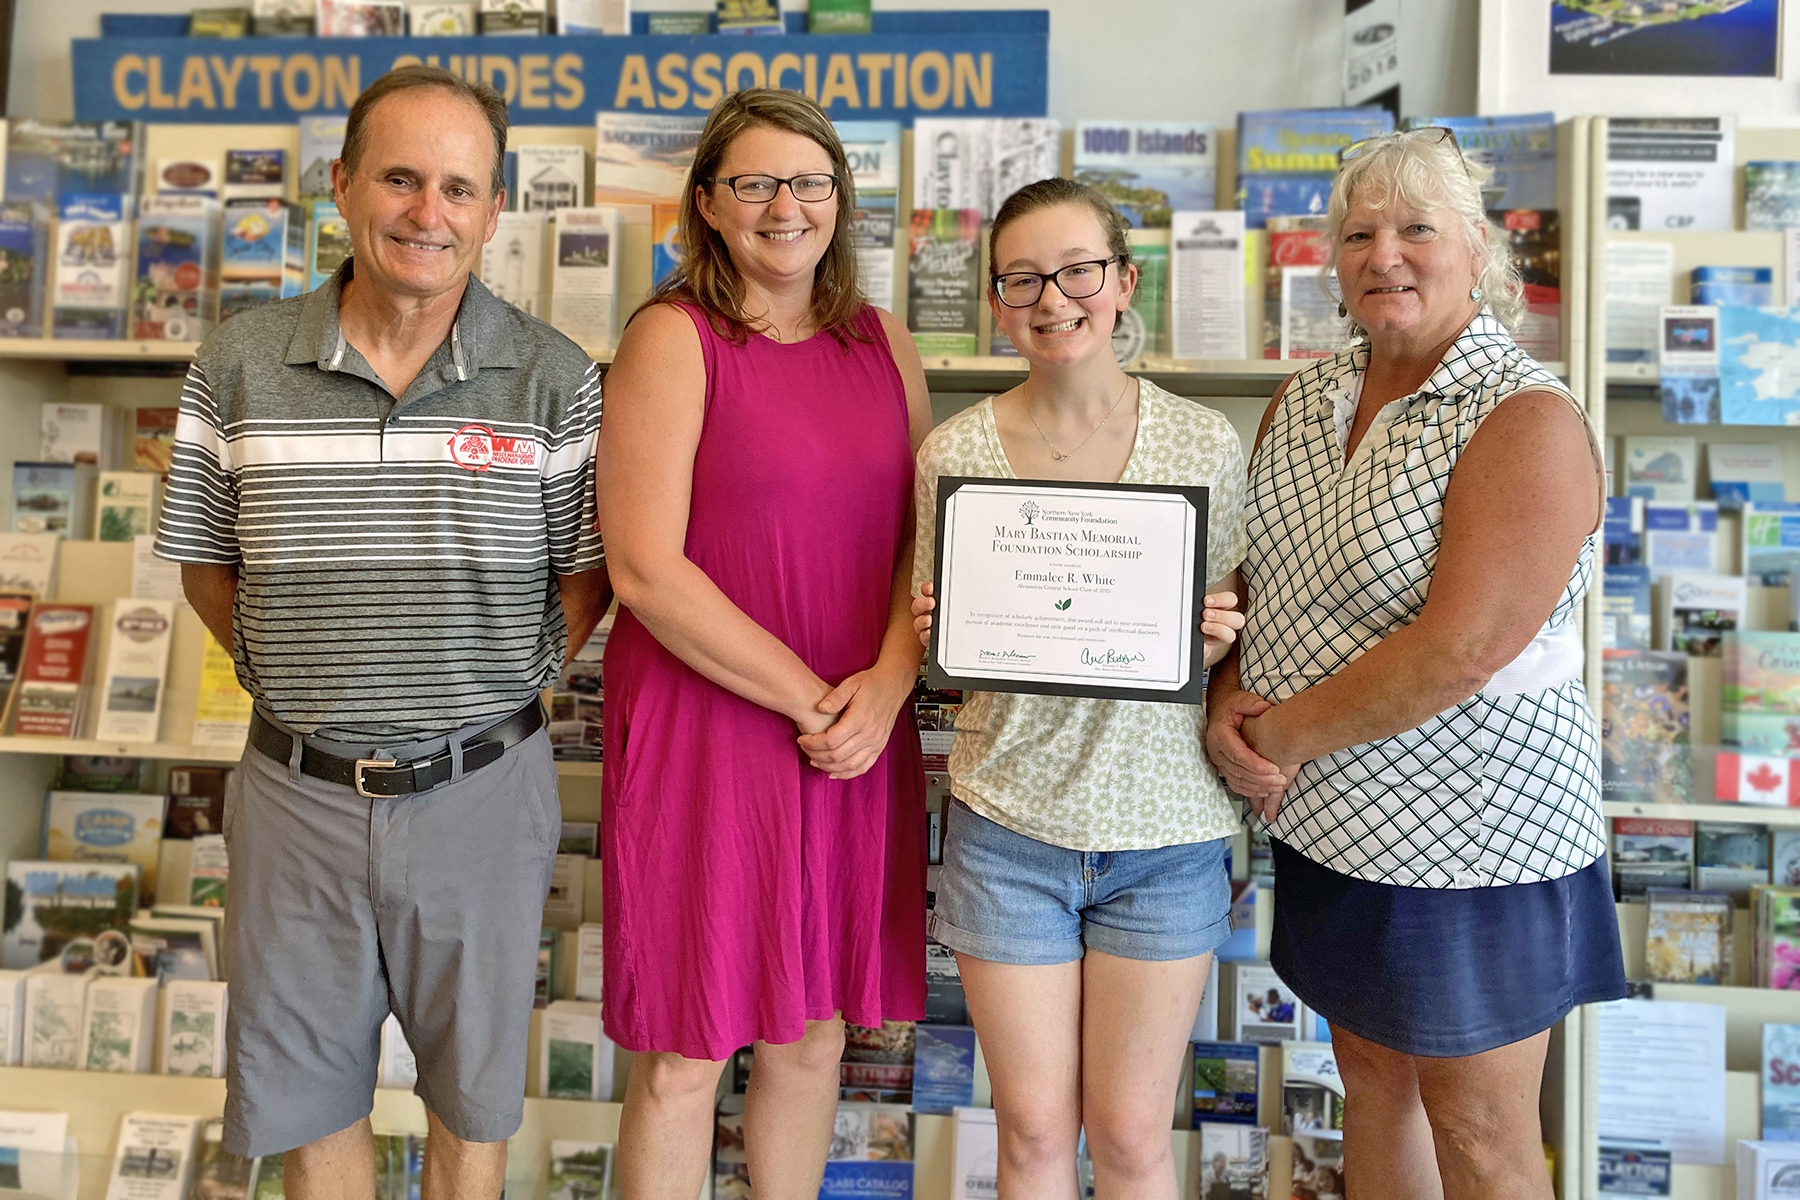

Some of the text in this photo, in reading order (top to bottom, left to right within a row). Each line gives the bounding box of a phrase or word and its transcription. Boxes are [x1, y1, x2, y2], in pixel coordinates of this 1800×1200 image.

[112, 52, 993, 110] CLAYTON IDES ASSOCIATION
[1348, 55, 1397, 91] 2018
[604, 131, 665, 147] SACKETS
[1083, 129, 1207, 155] 1000 Islands
[1042, 515, 1079, 524] Community
[1030, 527, 1077, 541] BASTIAN
[1081, 529, 1141, 545] MEMORIAL
[992, 540, 1142, 560] FOUNDATION SCHOLARSHIP
[1015, 569, 1116, 586] Emmalee R. White
[82, 814, 130, 828] CAMP
[1620, 823, 1691, 836] VISITOR CENTRE
[1599, 1162, 1667, 1179] CLAYTON
[821, 1178, 909, 1191] CLASS CATALOG
